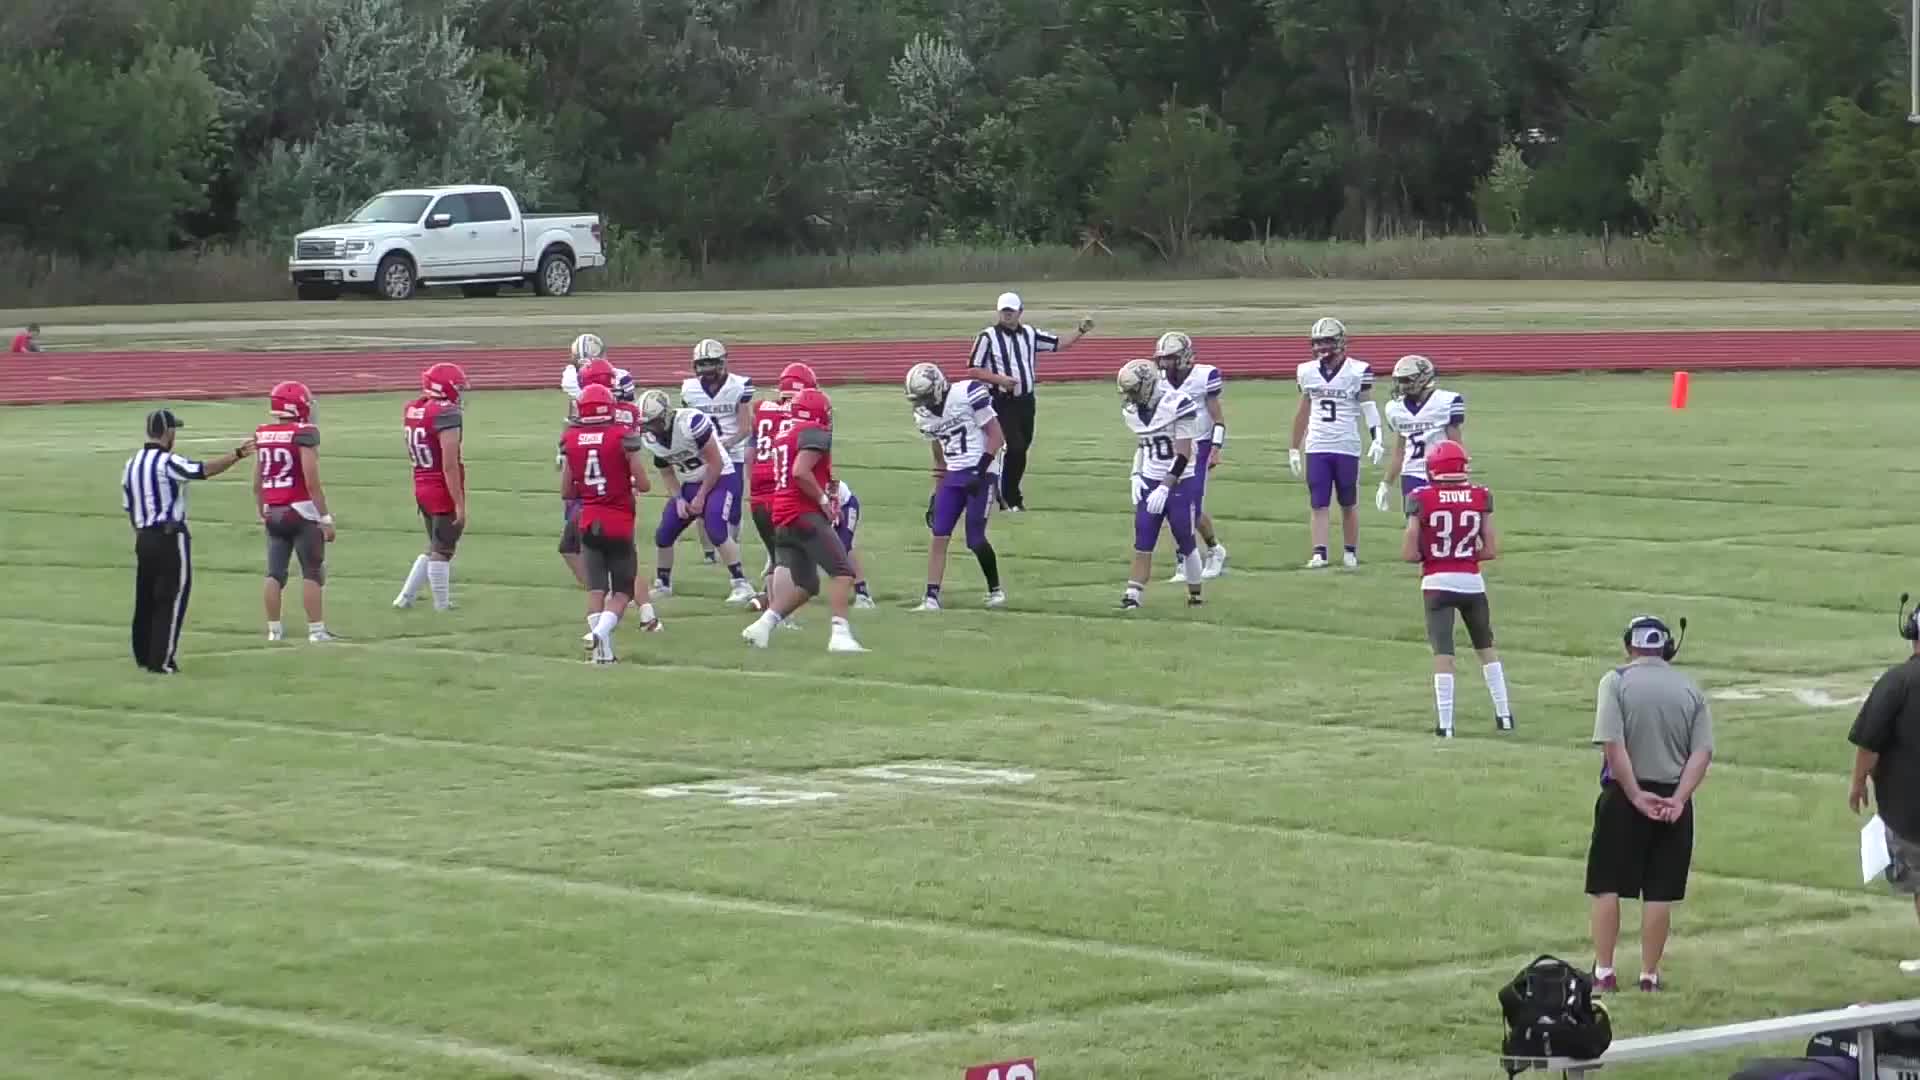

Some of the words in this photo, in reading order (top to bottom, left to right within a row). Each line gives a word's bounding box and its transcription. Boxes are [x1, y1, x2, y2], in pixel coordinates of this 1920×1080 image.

[1320, 399, 1337, 422] 9
[940, 426, 968, 457] 27
[259, 447, 294, 489] 22
[584, 449, 607, 496] 4
[1438, 489, 1473, 503] STOWE
[1429, 510, 1482, 558] 32
